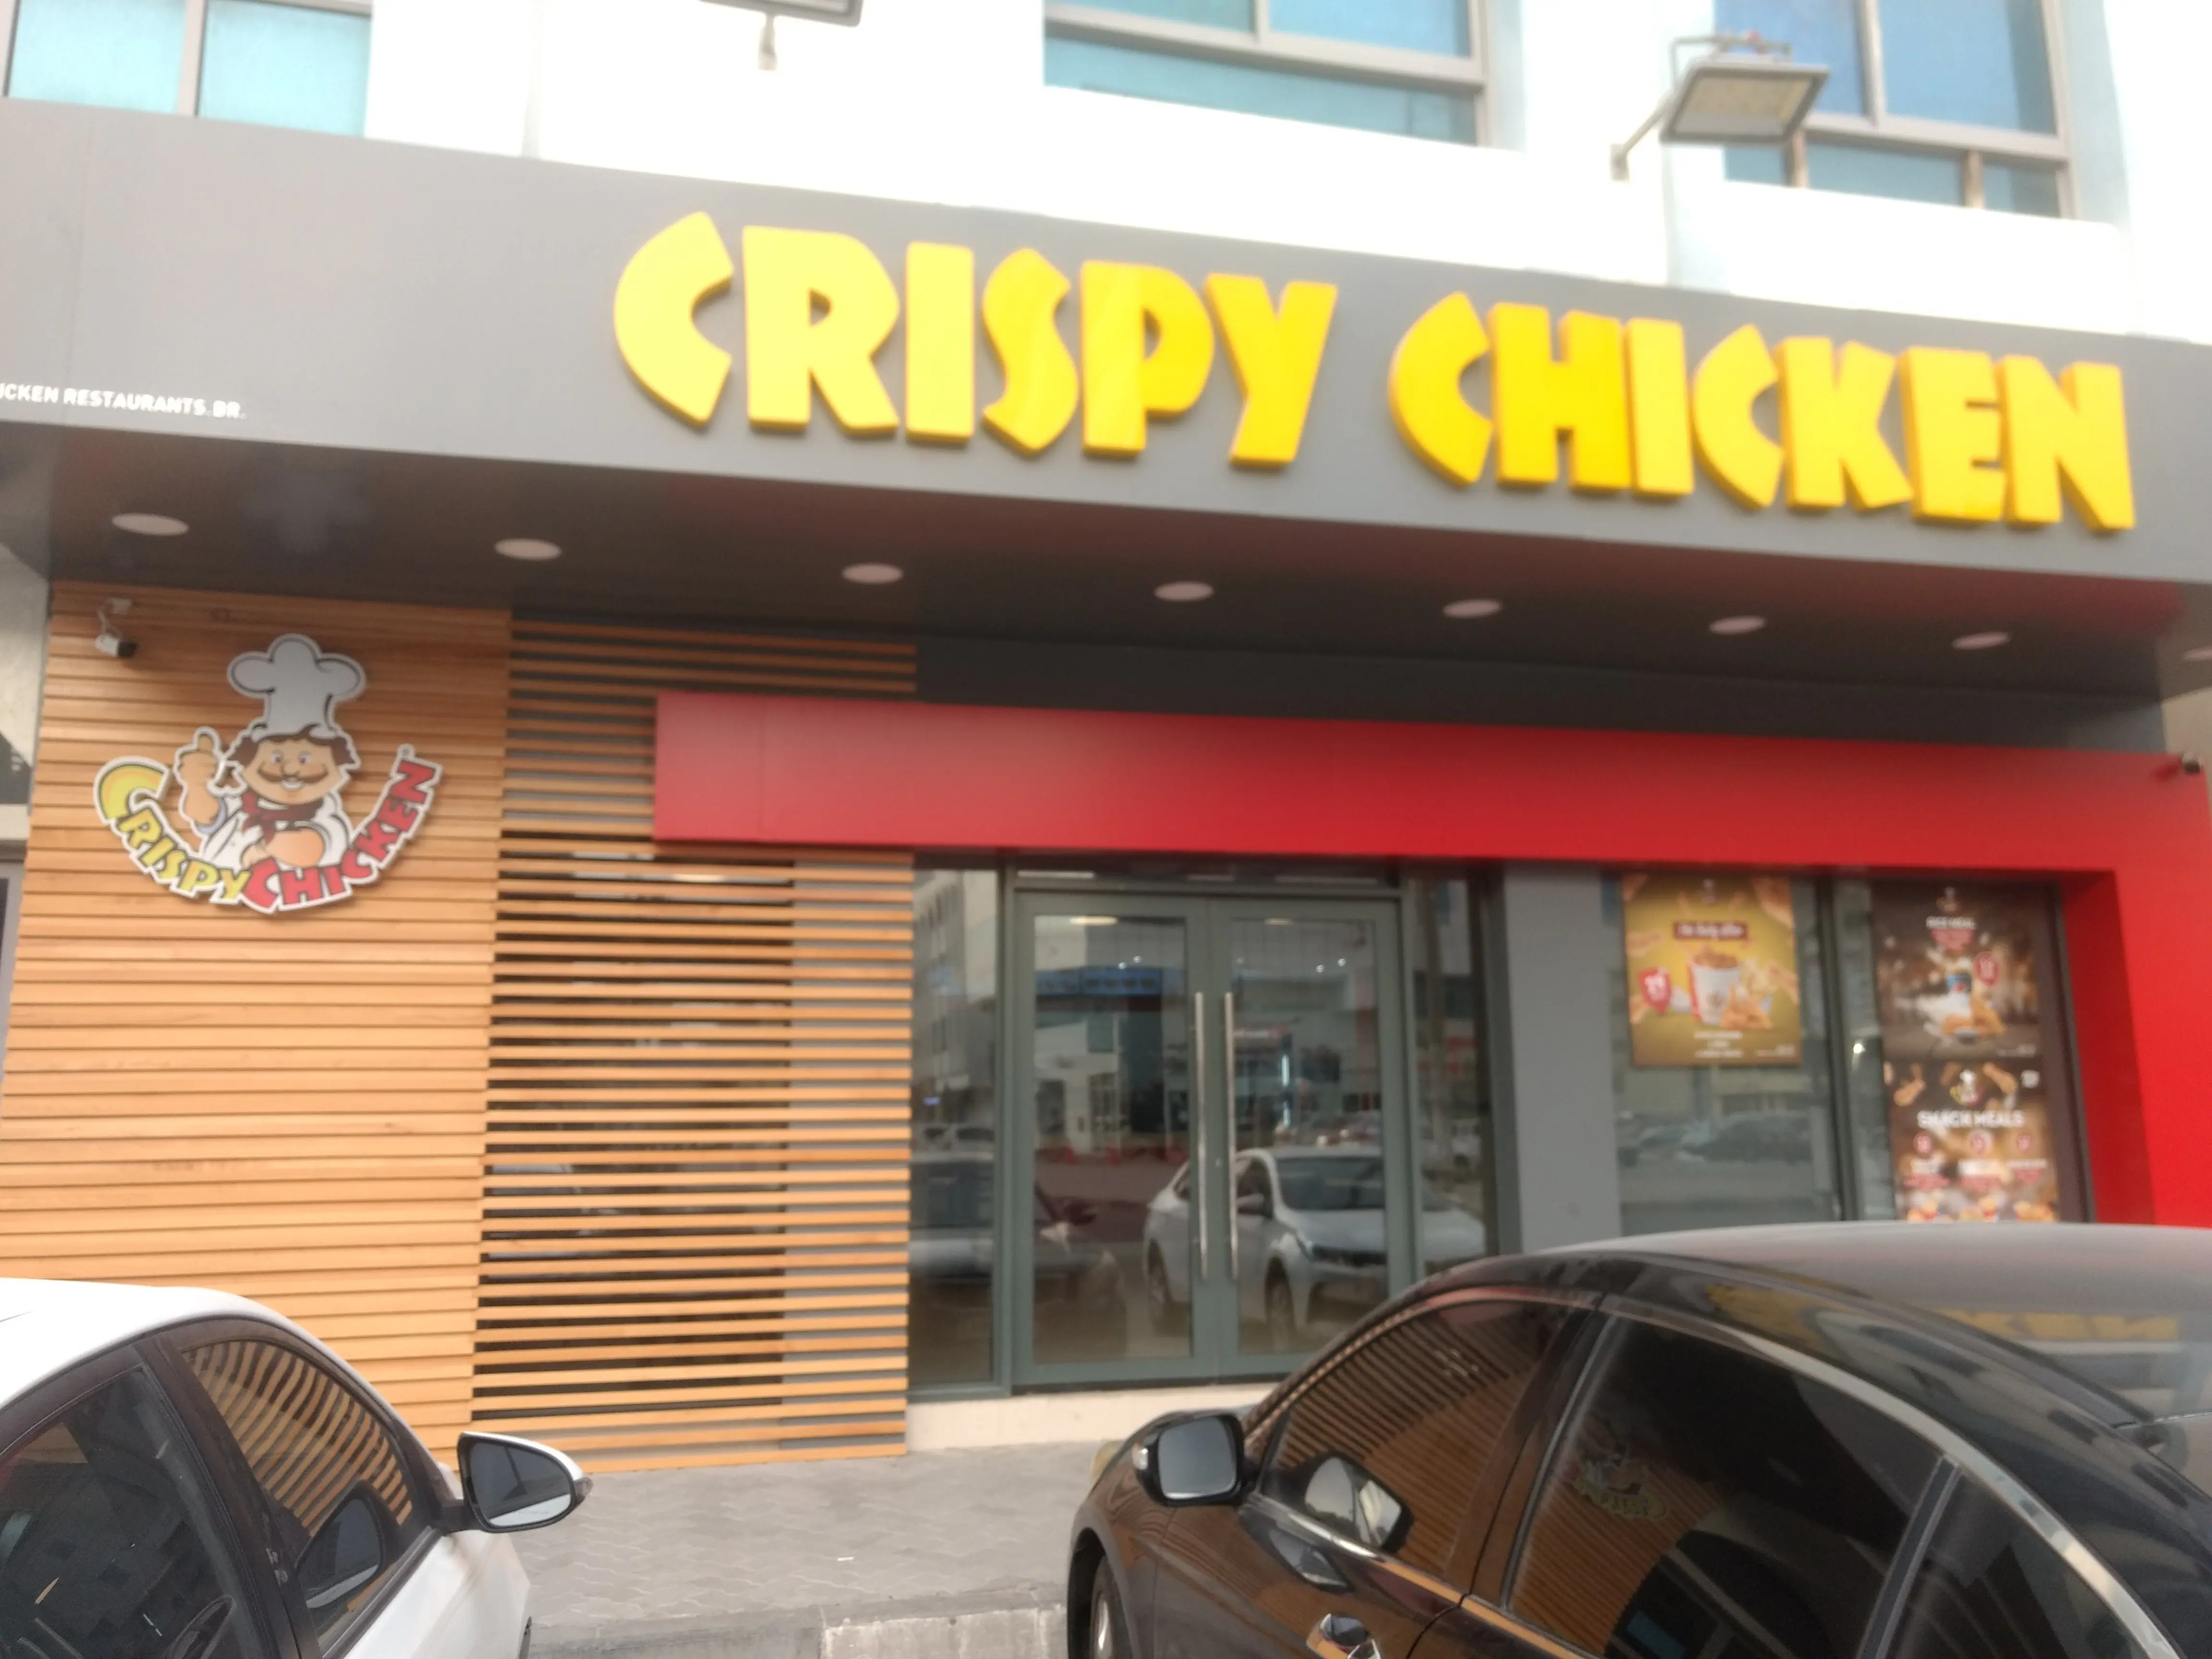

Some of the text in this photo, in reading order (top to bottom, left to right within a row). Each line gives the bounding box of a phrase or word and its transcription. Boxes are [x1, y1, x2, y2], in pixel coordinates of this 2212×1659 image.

[614, 212, 2136, 533] CRISPY CHICKEN
[98, 758, 437, 908] CRISPY CHICKEN
